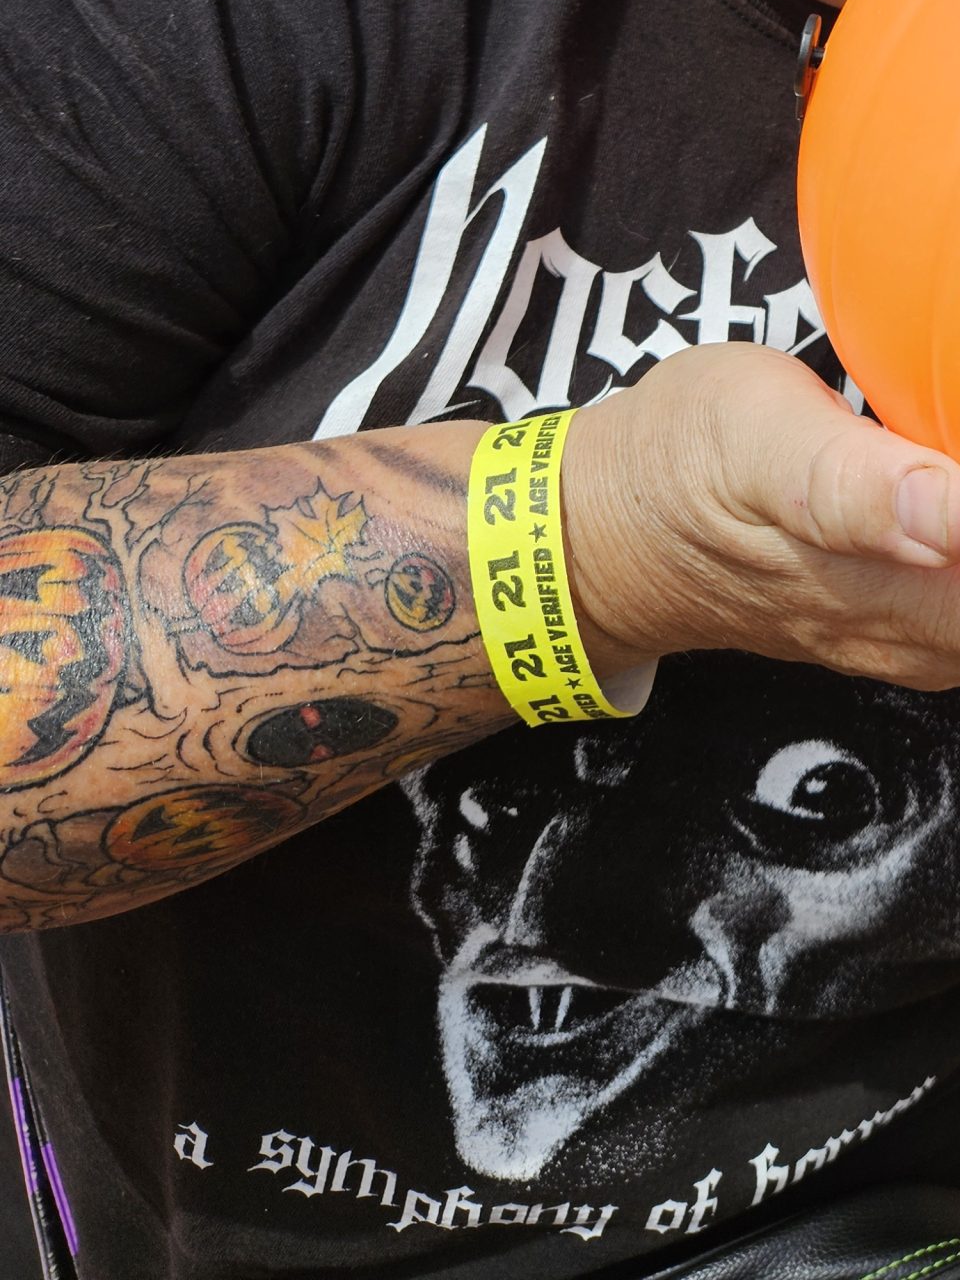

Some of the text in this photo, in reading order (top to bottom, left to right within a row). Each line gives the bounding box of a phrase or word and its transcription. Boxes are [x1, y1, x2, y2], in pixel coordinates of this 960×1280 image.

[528, 476, 549, 516] AGE
[483, 421, 573, 722] 21 21 21 21 21
[532, 547, 569, 642] VERIFIED
[551, 644, 581, 674] AGE
[173, 1121, 214, 1170] a
[246, 1128, 620, 1242] symphony
[644, 1167, 723, 1234] of
